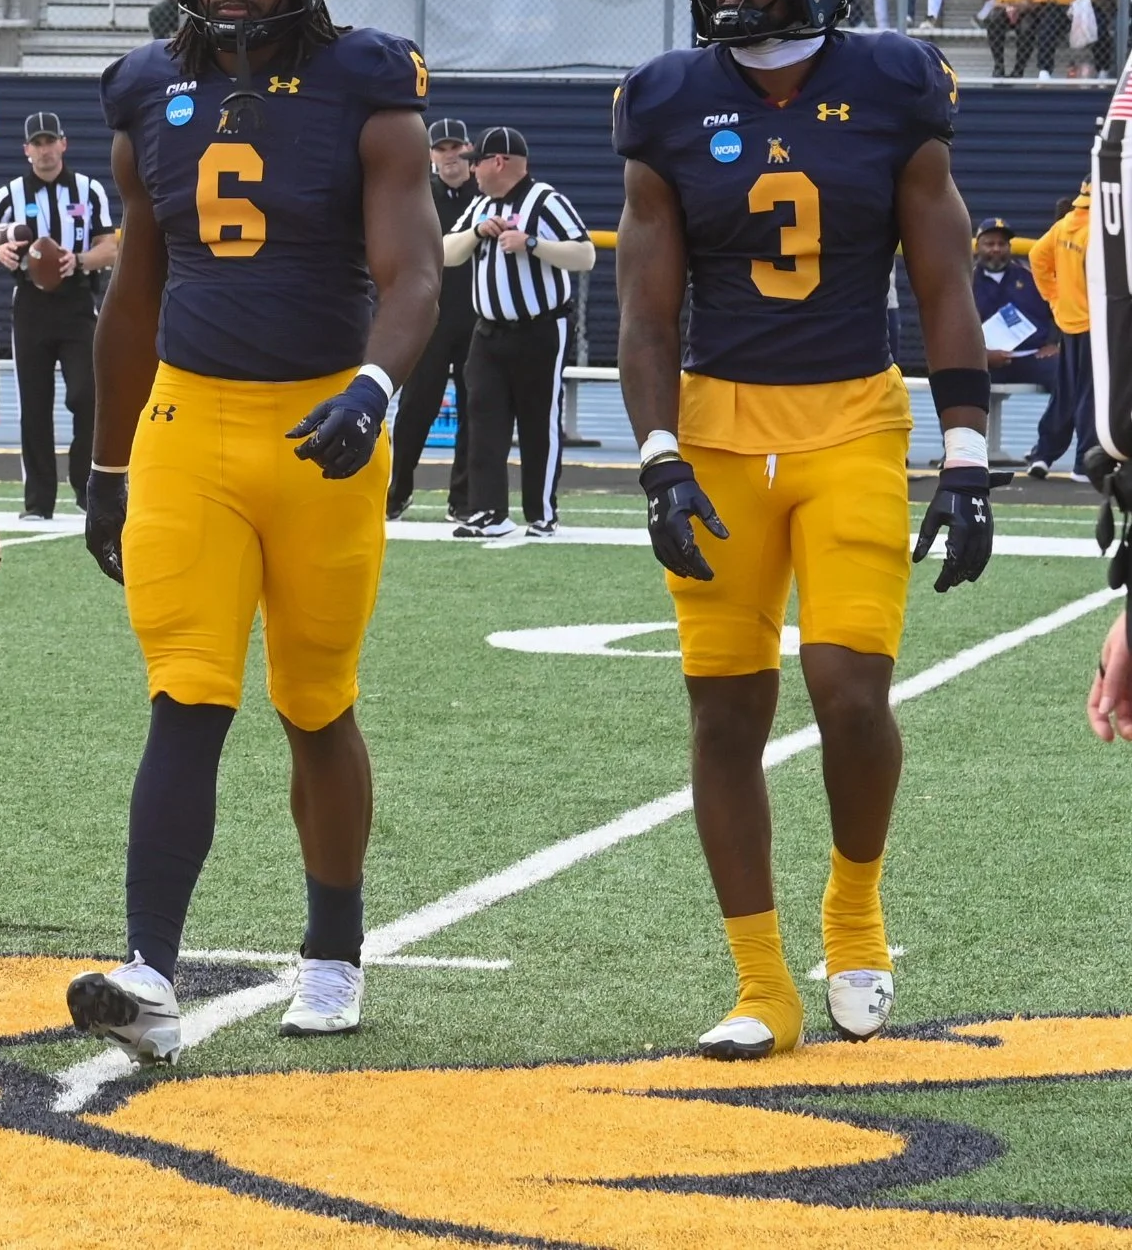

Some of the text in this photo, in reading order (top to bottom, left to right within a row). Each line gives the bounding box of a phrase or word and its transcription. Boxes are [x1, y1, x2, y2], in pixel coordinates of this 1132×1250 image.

[409, 51, 428, 97] 6
[165, 80, 198, 97] CIAA
[169, 107, 193, 120] NCAA
[703, 112, 739, 128] CIAA
[714, 144, 741, 156] NCAA
[196, 143, 267, 258] 6
[1101, 181, 1122, 236] U
[75, 226, 84, 241] B
[748, 171, 822, 301] 3
